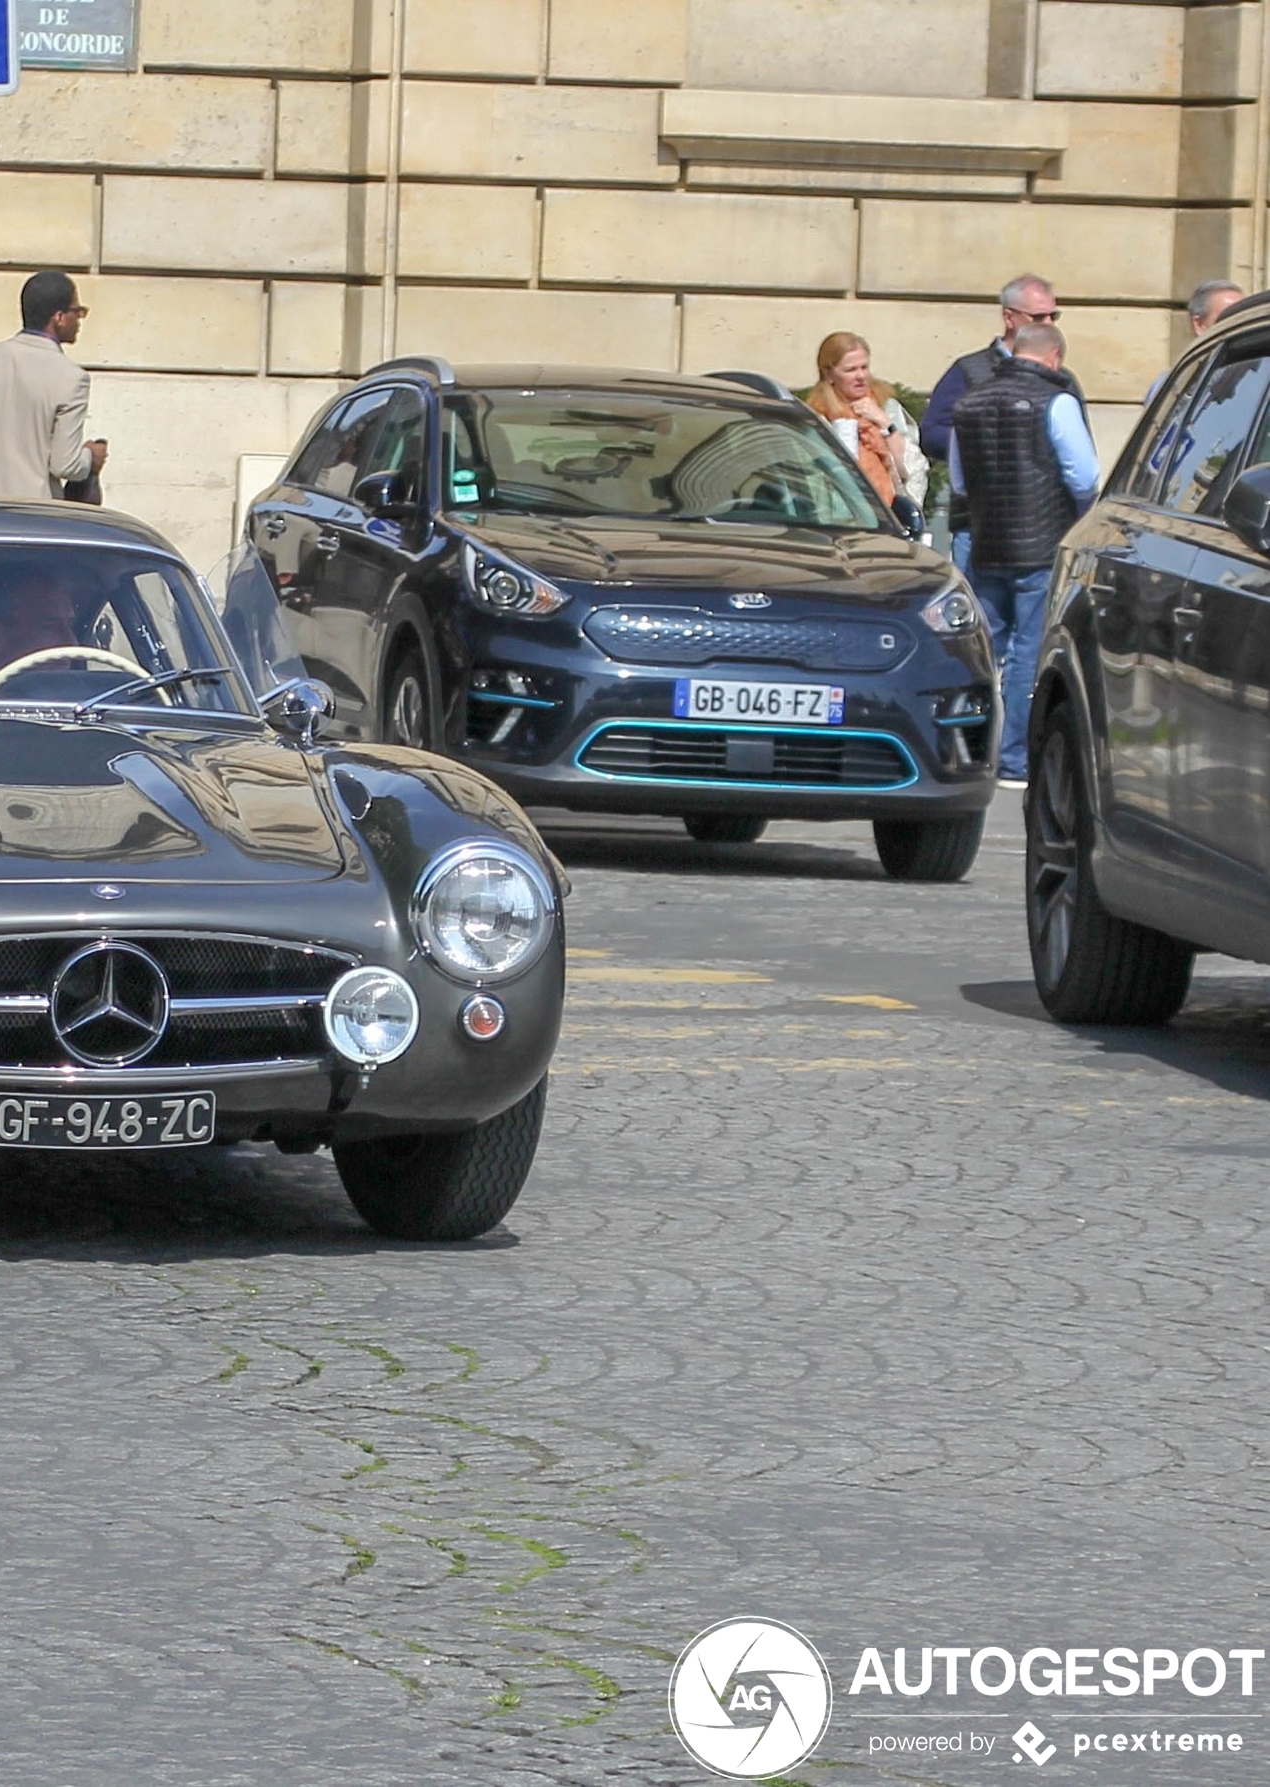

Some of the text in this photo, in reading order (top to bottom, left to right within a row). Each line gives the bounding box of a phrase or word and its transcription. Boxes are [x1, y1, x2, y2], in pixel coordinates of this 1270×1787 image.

[38, 8, 69, 25] DE
[694, 685, 824, 717] GB-046-FZ
[829, 703, 843, 718] 75
